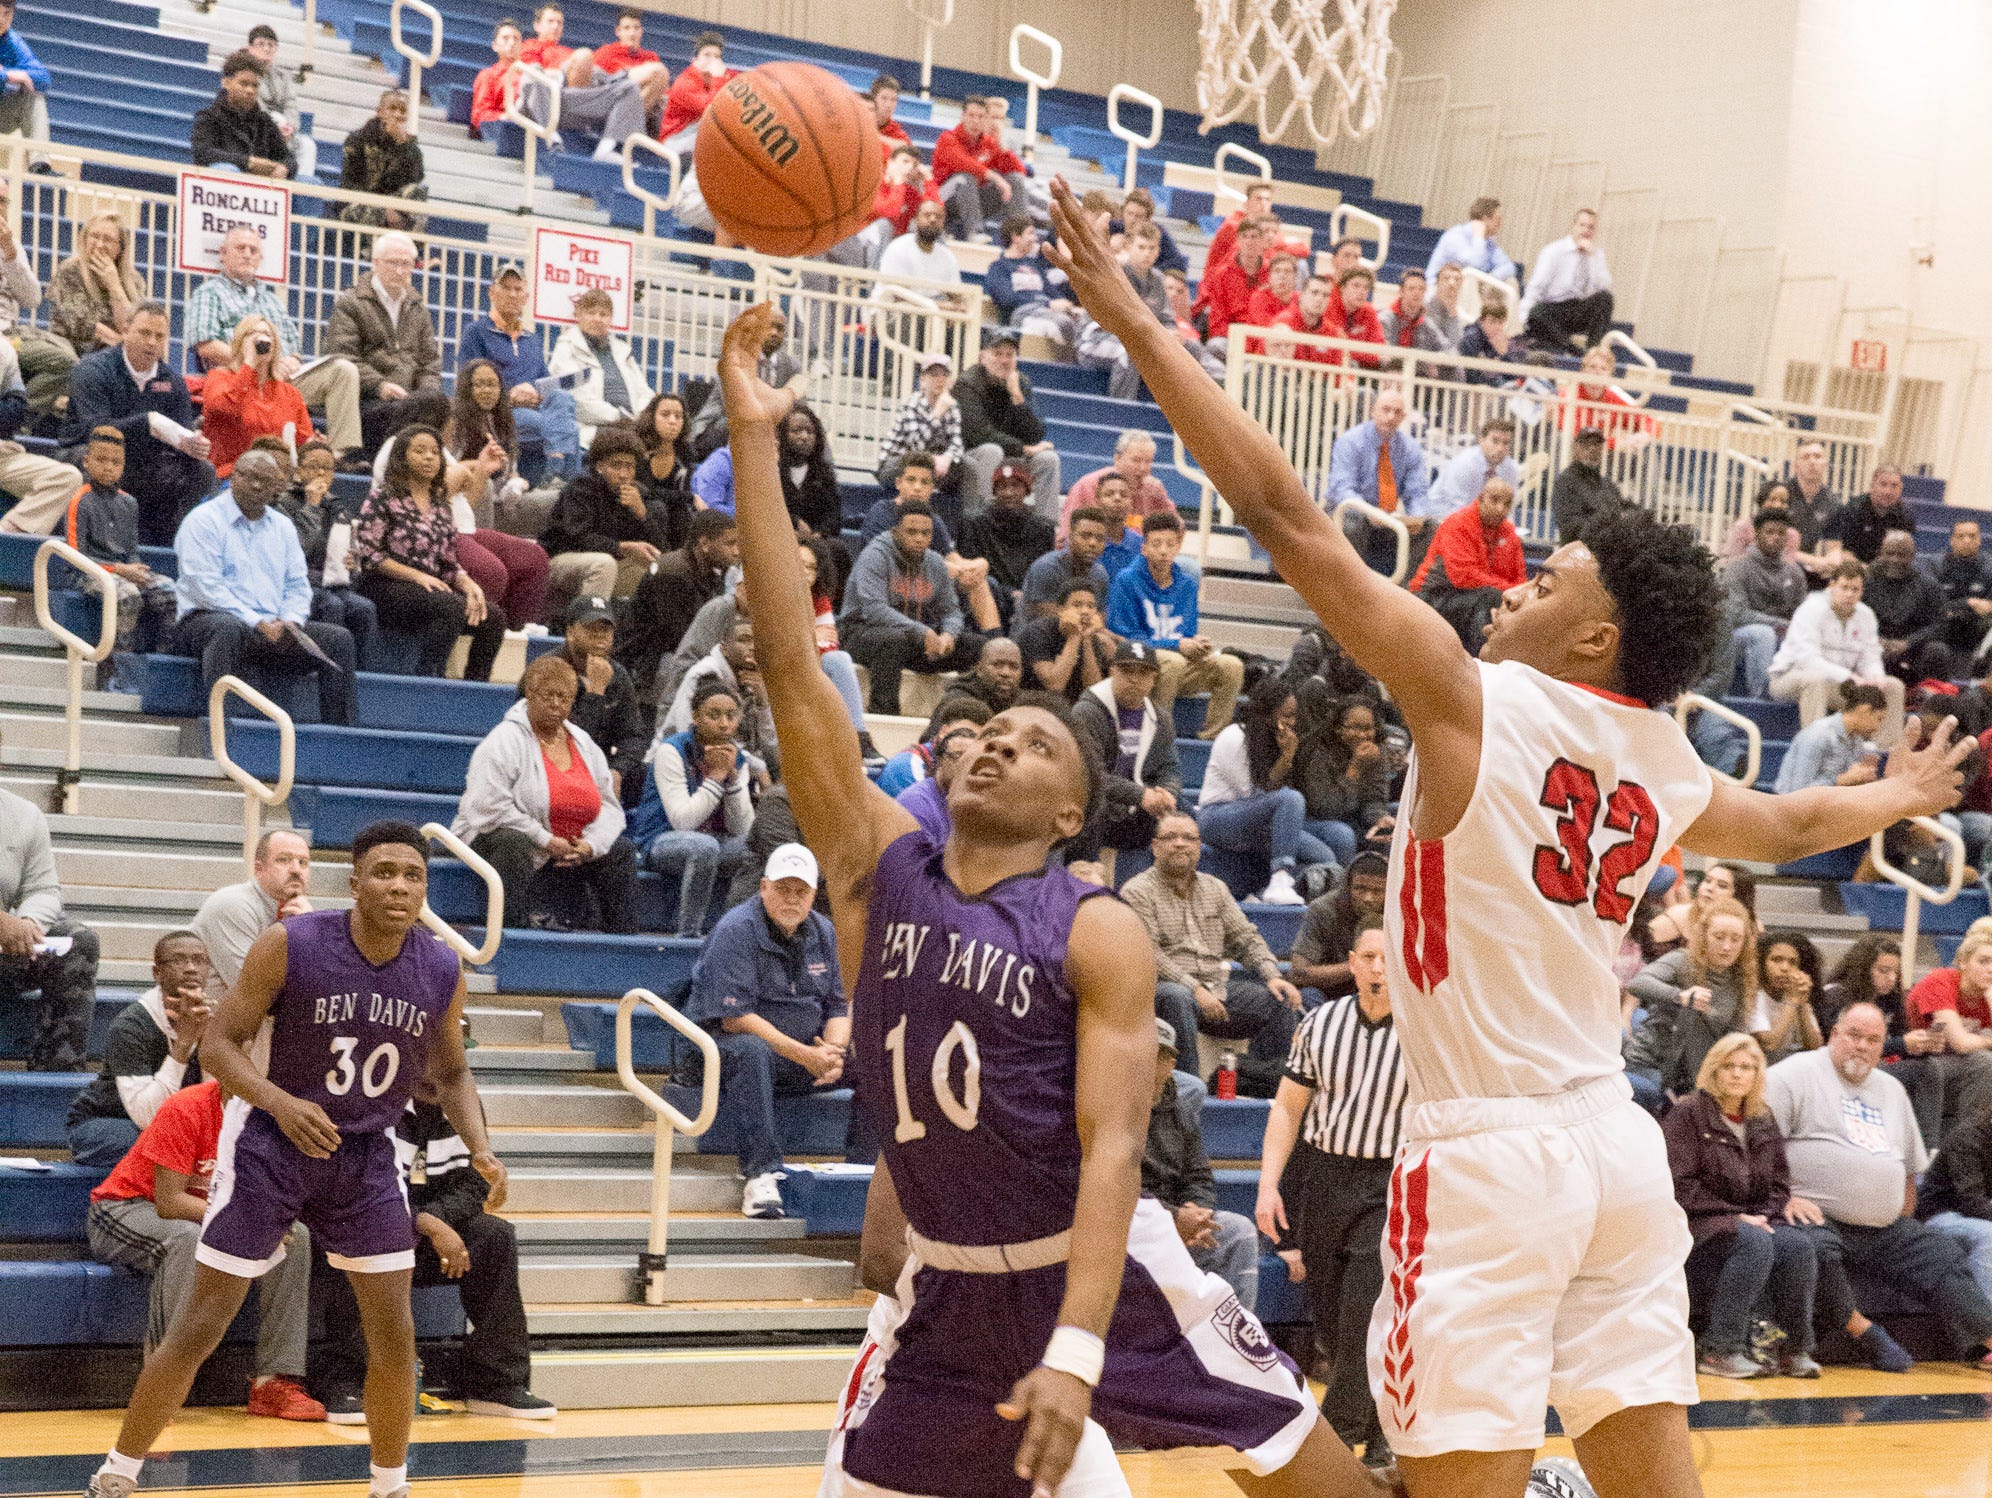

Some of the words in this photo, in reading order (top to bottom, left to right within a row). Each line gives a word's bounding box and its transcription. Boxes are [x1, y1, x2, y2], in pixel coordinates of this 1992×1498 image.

[192, 184, 279, 217] RONCALLI
[545, 263, 570, 285] RED
[576, 267, 622, 292] DEVILS
[569, 243, 600, 265] PIKE
[1531, 756, 1661, 927] 32
[938, 932, 1036, 1019] DAVIS
[313, 992, 359, 1025] BEN
[368, 992, 428, 1038] DAVIS
[324, 1036, 401, 1099] 30
[884, 1012, 982, 1144] 10
